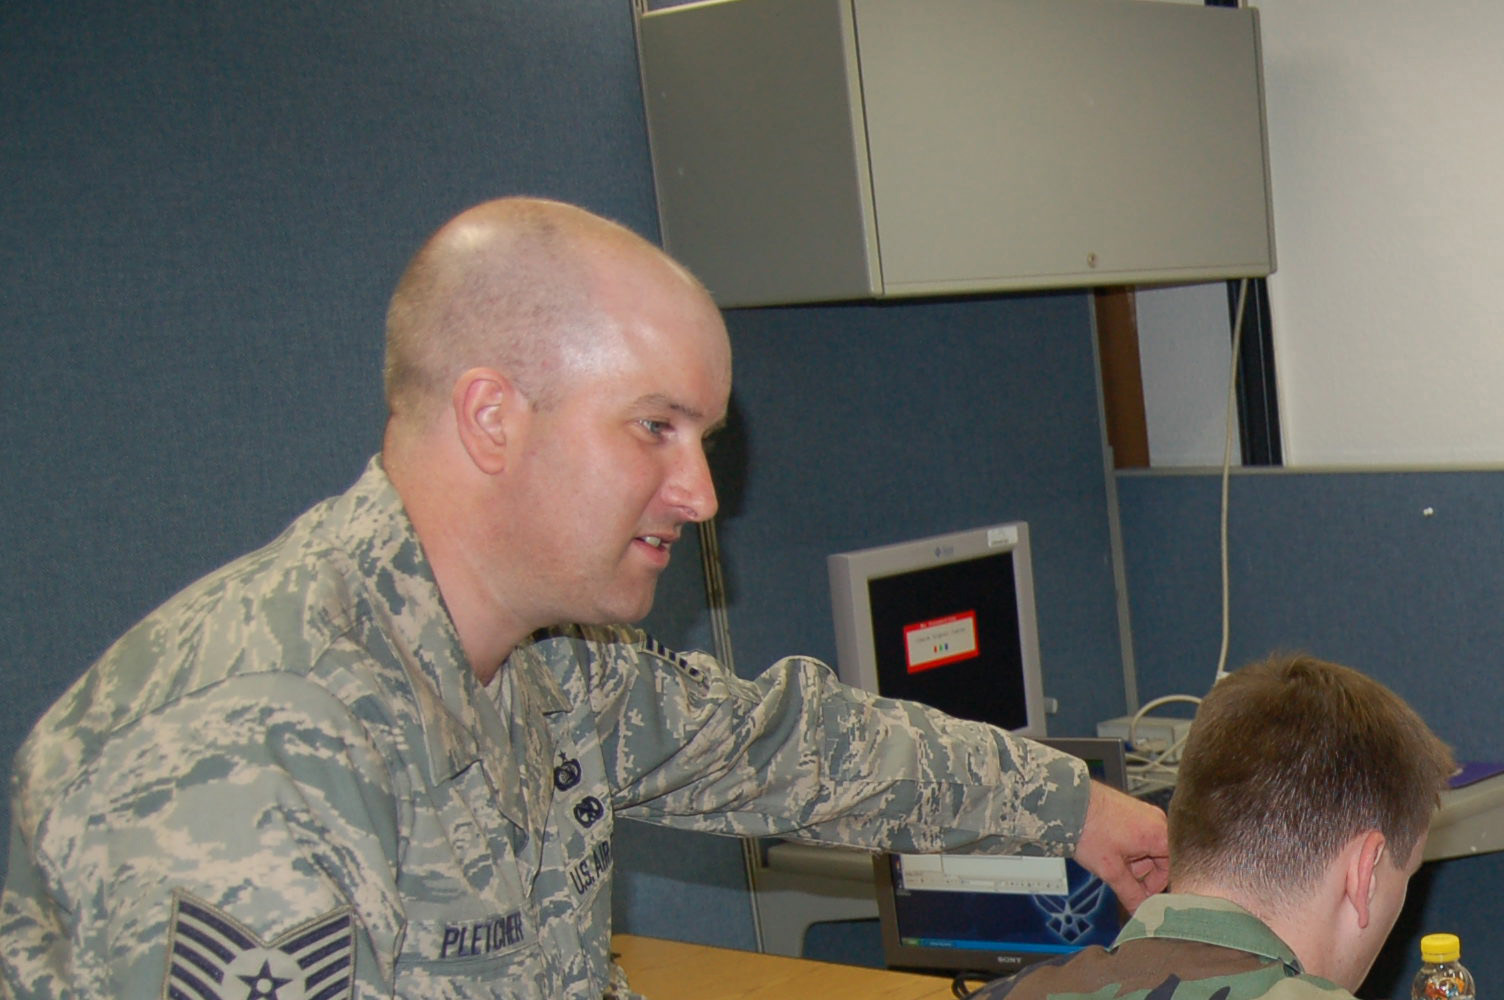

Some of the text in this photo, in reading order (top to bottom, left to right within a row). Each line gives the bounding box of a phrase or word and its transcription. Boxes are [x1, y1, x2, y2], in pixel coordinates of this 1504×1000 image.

[570, 840, 611, 895] U.S. AIR
[441, 911, 524, 959] PLETCHER
